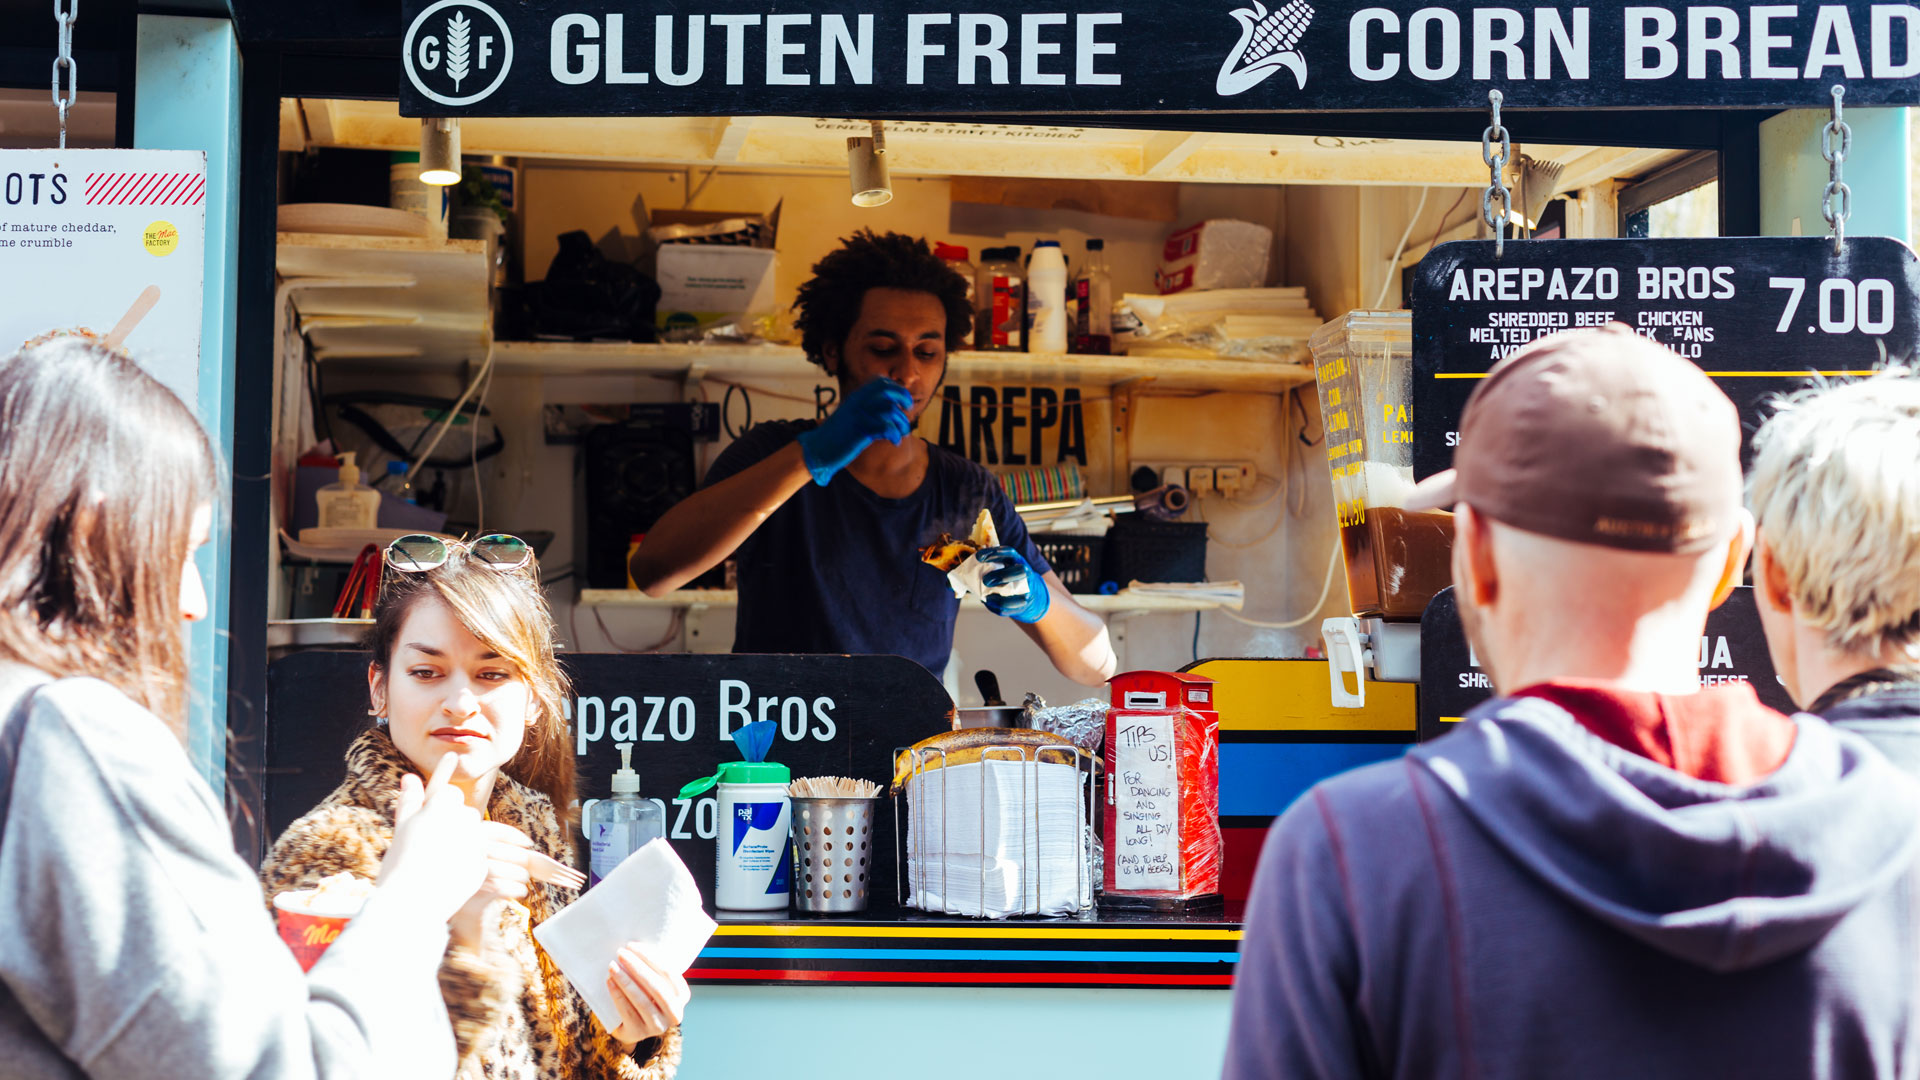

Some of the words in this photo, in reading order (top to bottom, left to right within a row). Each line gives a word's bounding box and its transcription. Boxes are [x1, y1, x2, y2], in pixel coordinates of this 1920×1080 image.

[550, 13, 874, 85] GLUTEN
[906, 12, 1123, 85] FREE
[1348, 6, 1590, 81] CORN
[1624, 4, 1920, 80] BREAD
[418, 35, 440, 70] G
[478, 36, 493, 69] F
[815, 123, 929, 133] VENEZELAN
[1005, 131, 1081, 139] KITCHEN
[0, 222, 8, 232] f
[10, 223, 58, 232] mature
[61, 222, 117, 233] cheddar,
[145, 232, 157, 240] THE
[157, 229, 177, 239] Mac
[20, 238, 73, 248] crumble
[145, 239, 171, 247] FACTORY
[1448, 267, 1619, 302] AREPAZO
[1636, 266, 1735, 300] BROS
[1768, 276, 1895, 335] 7.00
[1488, 312, 1569, 327] SHREDDED
[1574, 311, 1616, 327] BEEF
[1638, 311, 1703, 327] CHICKEN
[1469, 328, 1531, 343] MELTED
[1383, 404, 1413, 423] PA
[938, 385, 1087, 466] AREPA
[1337, 497, 1366, 529] £2.50
[719, 679, 838, 742] Bros
[1119, 724, 1157, 748] TIPS
[1148, 740, 1173, 770] US!
[1123, 770, 1143, 785] FOR
[1130, 786, 1171, 797] DANCING
[738, 807, 752, 816] pal
[1135, 800, 1156, 810] AND
[1123, 811, 1161, 821] SINGING
[1135, 824, 1153, 835] ALL
[1155, 822, 1173, 837] DAY
[1117, 854, 1140, 867] (AND
[1142, 854, 1152, 864] TO
[1152, 853, 1168, 864] HELP
[1123, 865, 1132, 875] US
